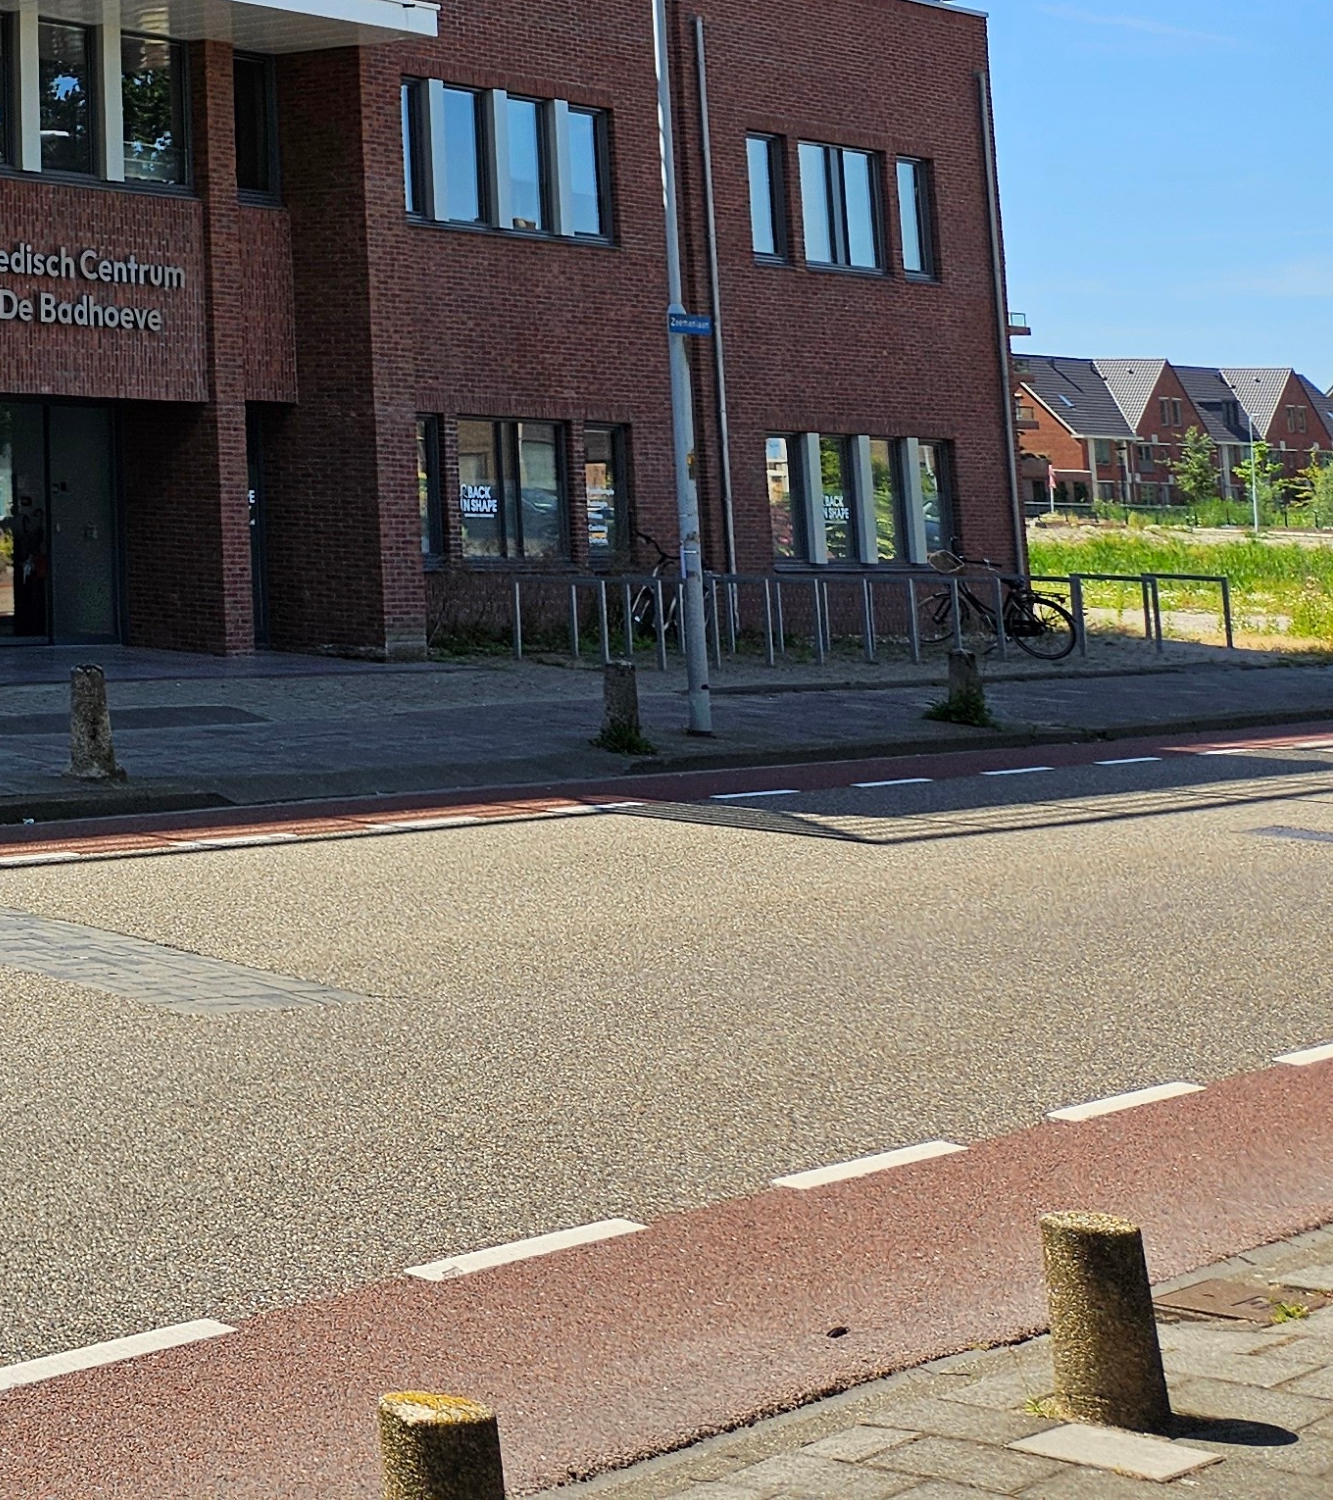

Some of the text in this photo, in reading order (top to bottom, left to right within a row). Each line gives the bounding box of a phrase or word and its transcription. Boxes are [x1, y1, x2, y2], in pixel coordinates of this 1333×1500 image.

[80, 249, 186, 289] Centrum
[39, 291, 163, 332] Badhoeve
[467, 485, 492, 499] BACK
[471, 499, 498, 513] SHAPE
[824, 494, 844, 507] BACK
[828, 507, 849, 520] SHAPE
